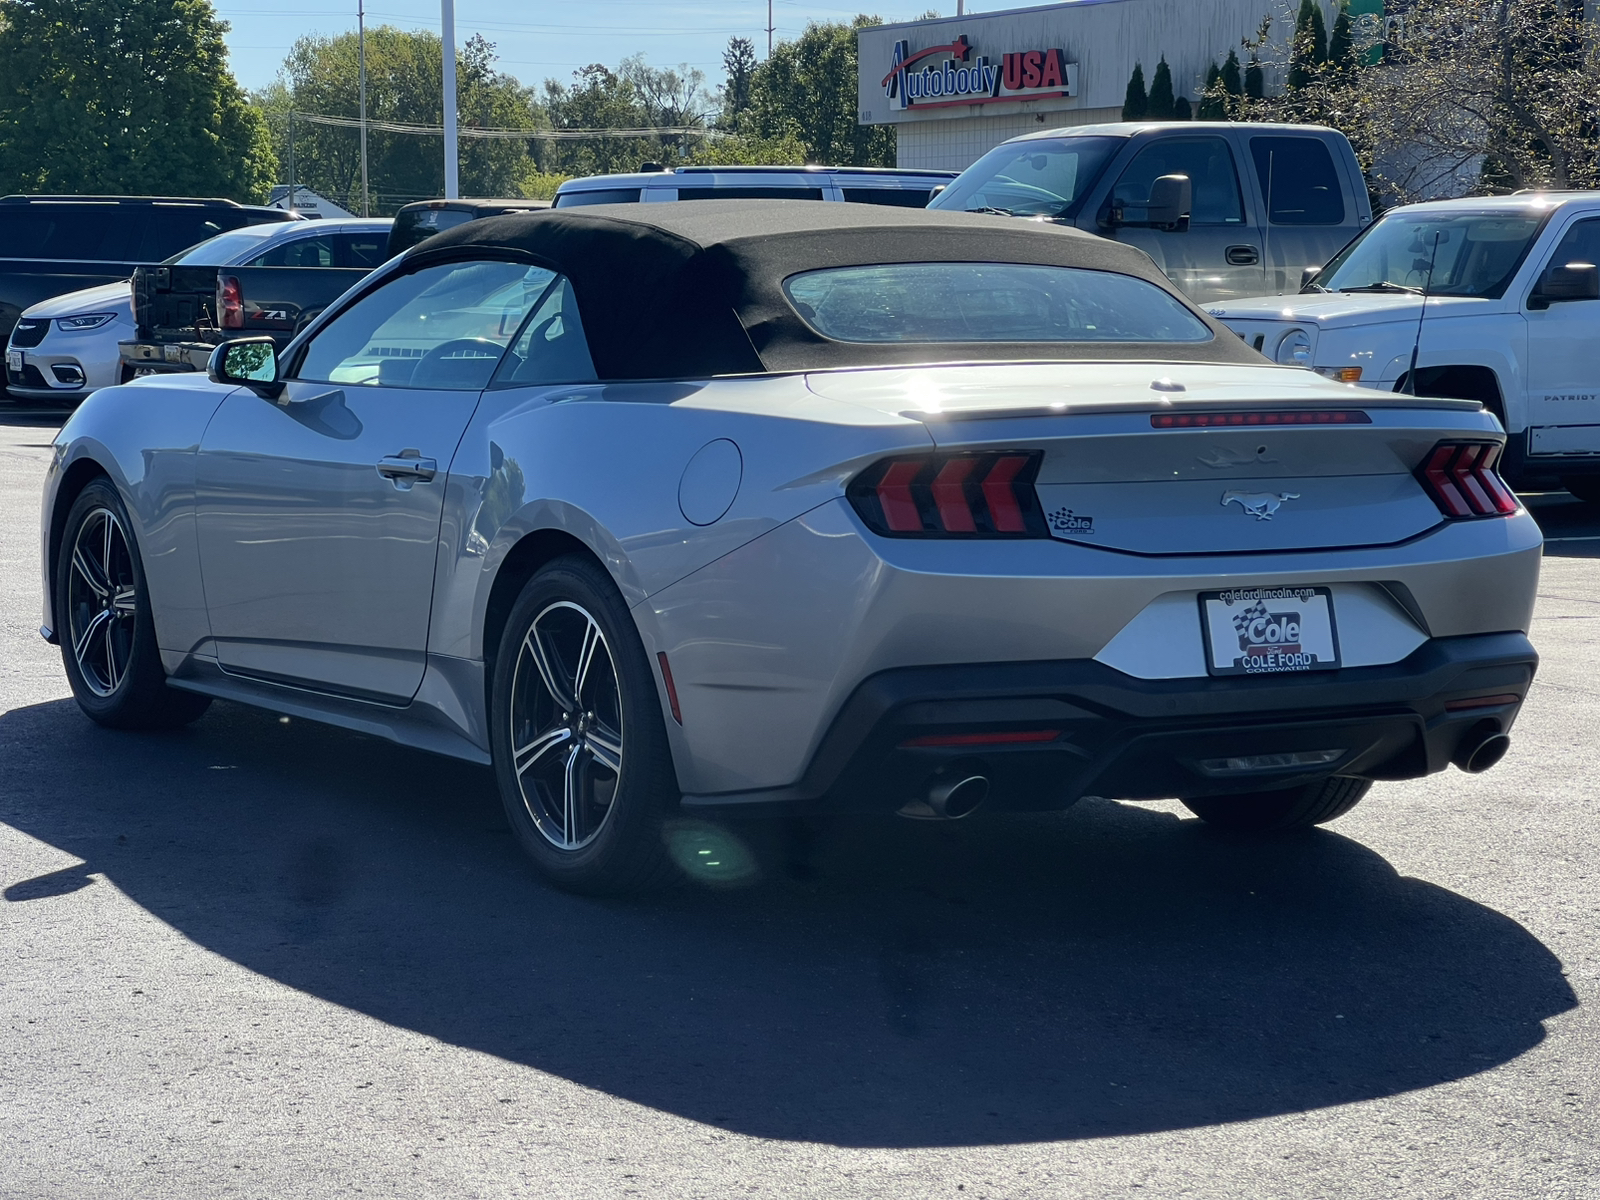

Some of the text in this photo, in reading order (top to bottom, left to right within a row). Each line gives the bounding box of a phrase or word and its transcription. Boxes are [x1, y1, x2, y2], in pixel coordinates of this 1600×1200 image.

[885, 39, 1064, 110] Autobody USA
[251, 310, 286, 319] Z71
[1543, 394, 1598, 402] PATRIOT
[1056, 518, 1090, 529] Cole
[1219, 587, 1315, 601] colefordlincoln.com
[1248, 617, 1300, 643] Cole
[1242, 653, 1312, 669] COLE FORD
[1246, 665, 1310, 674] COLDWATER
